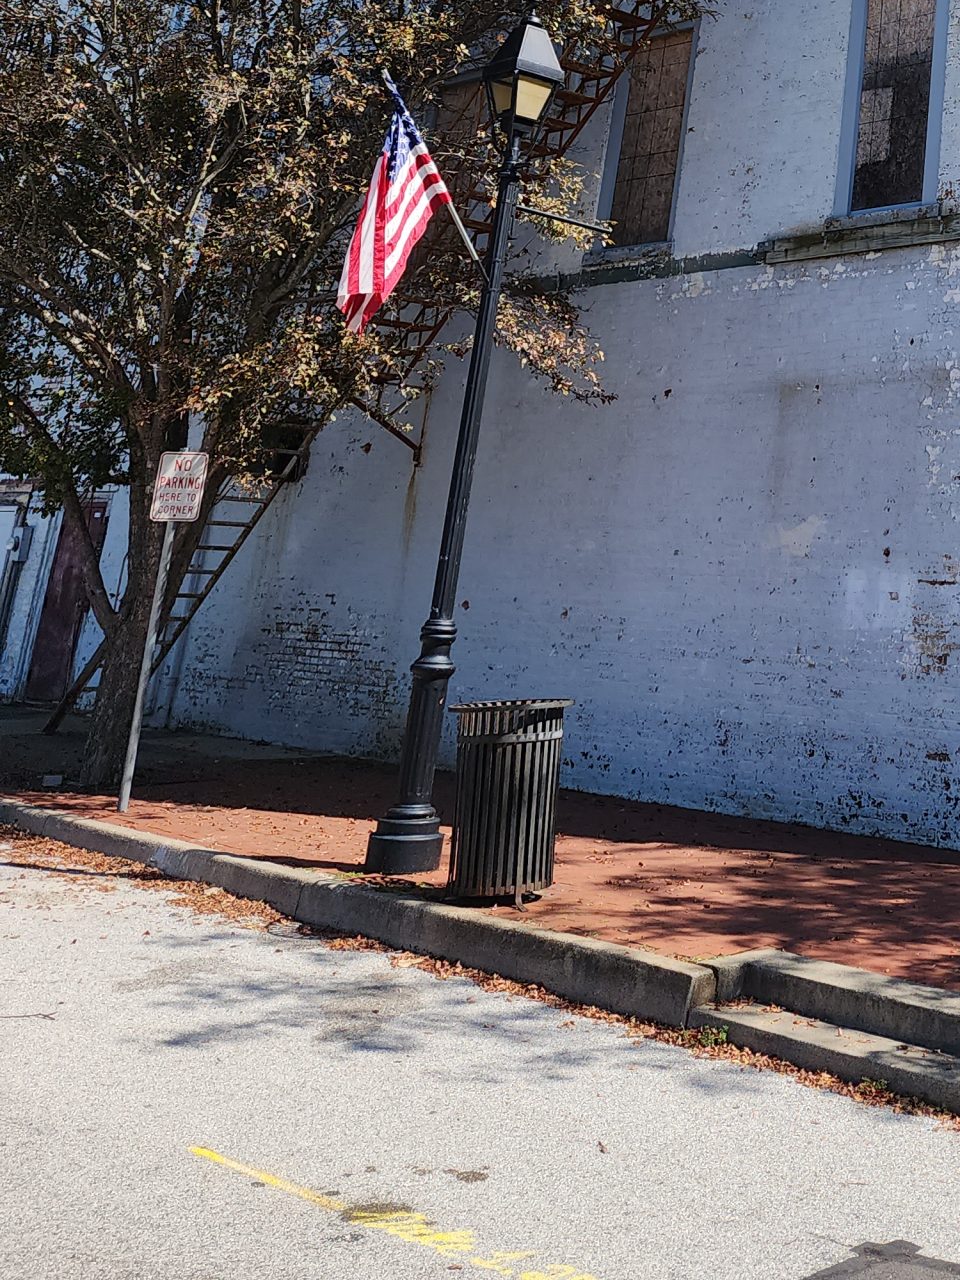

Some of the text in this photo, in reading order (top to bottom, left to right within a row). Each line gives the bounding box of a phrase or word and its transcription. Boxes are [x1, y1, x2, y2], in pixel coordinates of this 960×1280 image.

[174, 460, 192, 471] NO
[160, 477, 201, 489] PARKING
[160, 493, 196, 502] HERE TO
[158, 505, 194, 514] CORNER
